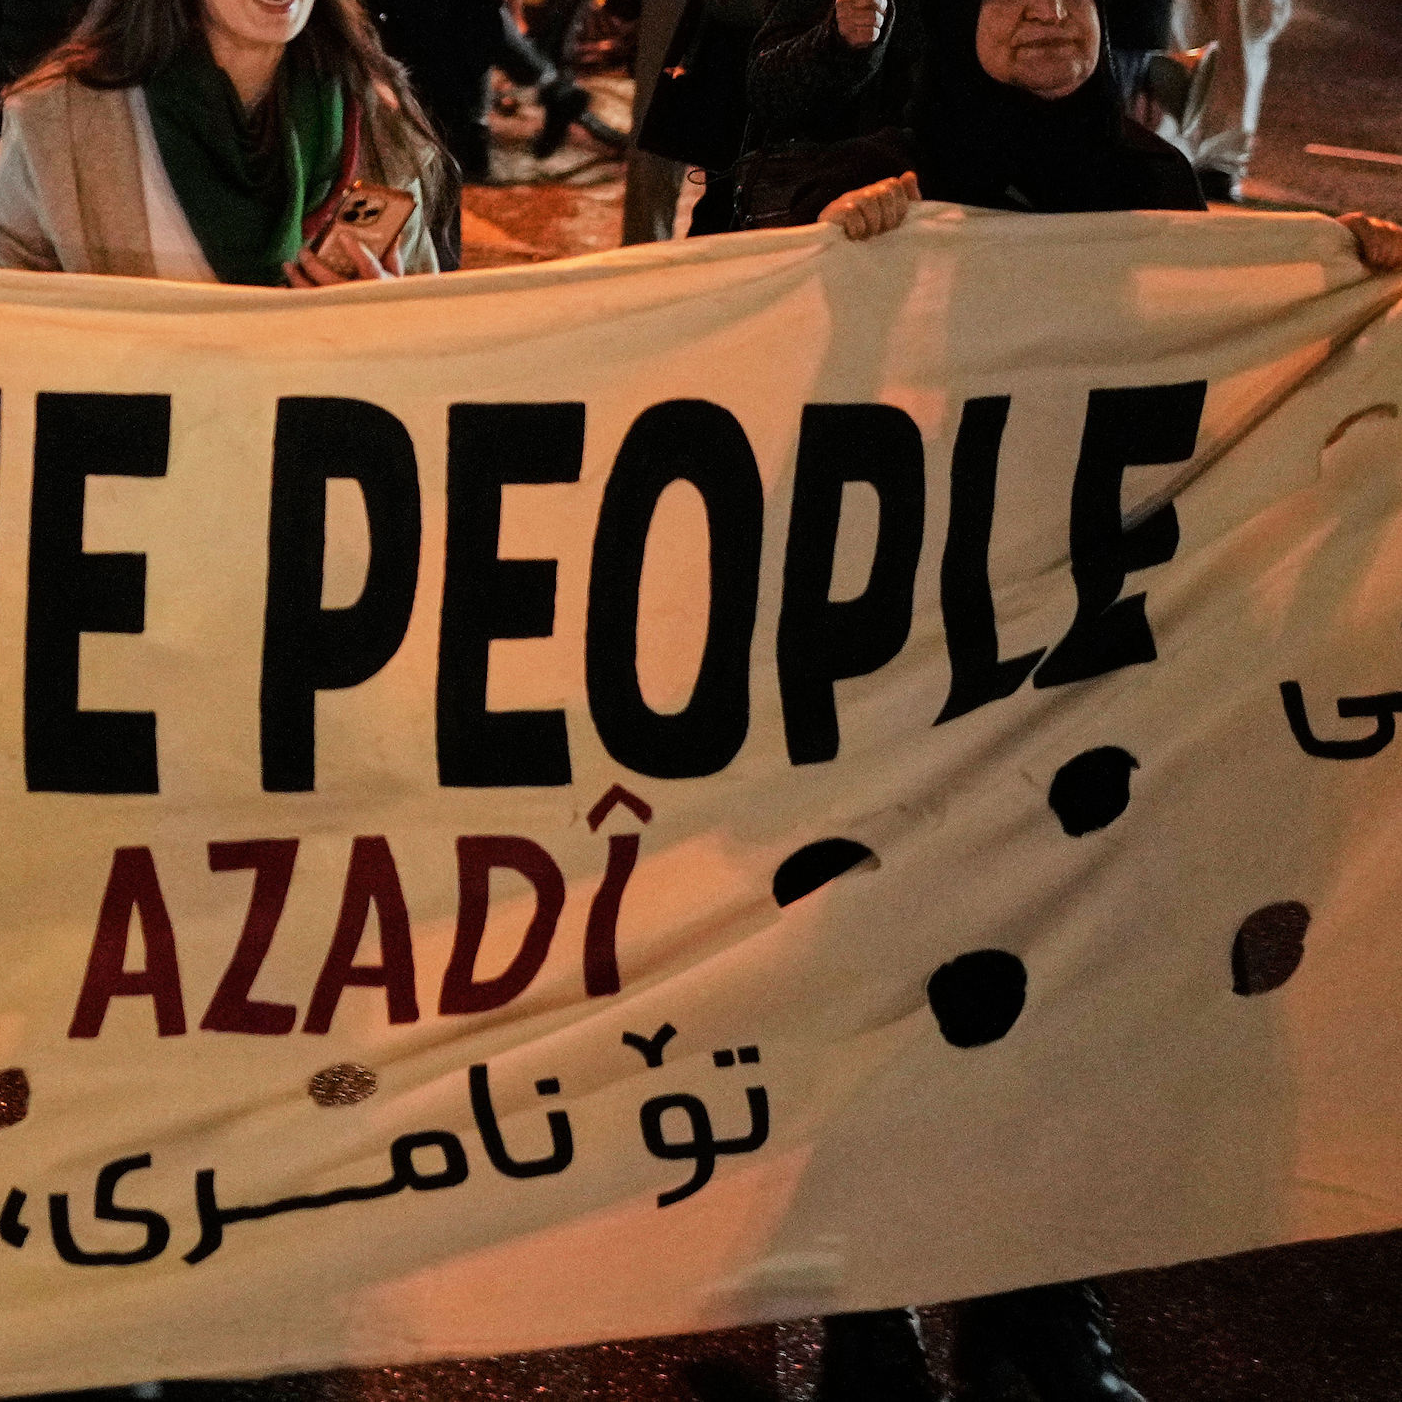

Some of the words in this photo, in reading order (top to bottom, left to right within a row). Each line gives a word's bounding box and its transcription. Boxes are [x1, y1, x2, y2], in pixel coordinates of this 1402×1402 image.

[258, 380, 1208, 795] PEOPLE
[67, 783, 654, 1039] AZADÎ
[621, 1022, 771, 1208] تۆ
